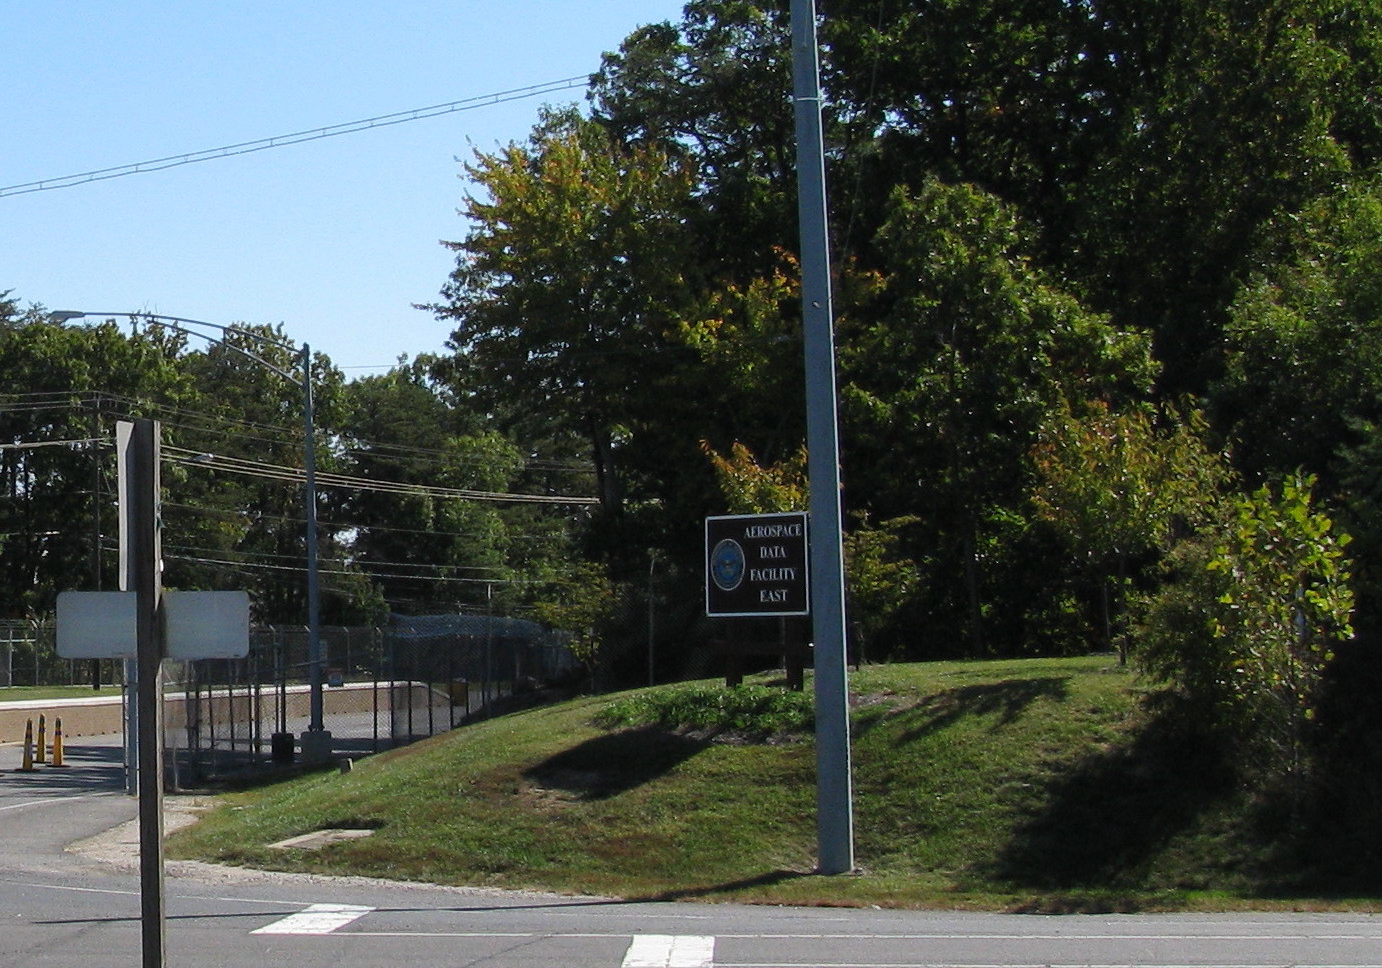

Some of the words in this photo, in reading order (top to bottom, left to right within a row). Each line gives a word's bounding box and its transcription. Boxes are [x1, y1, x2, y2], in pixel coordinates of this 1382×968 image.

[744, 524, 802, 538] AEROSPACE
[760, 546, 786, 558] DATA
[750, 568, 796, 581] FACILITY
[760, 590, 788, 602] EAST
